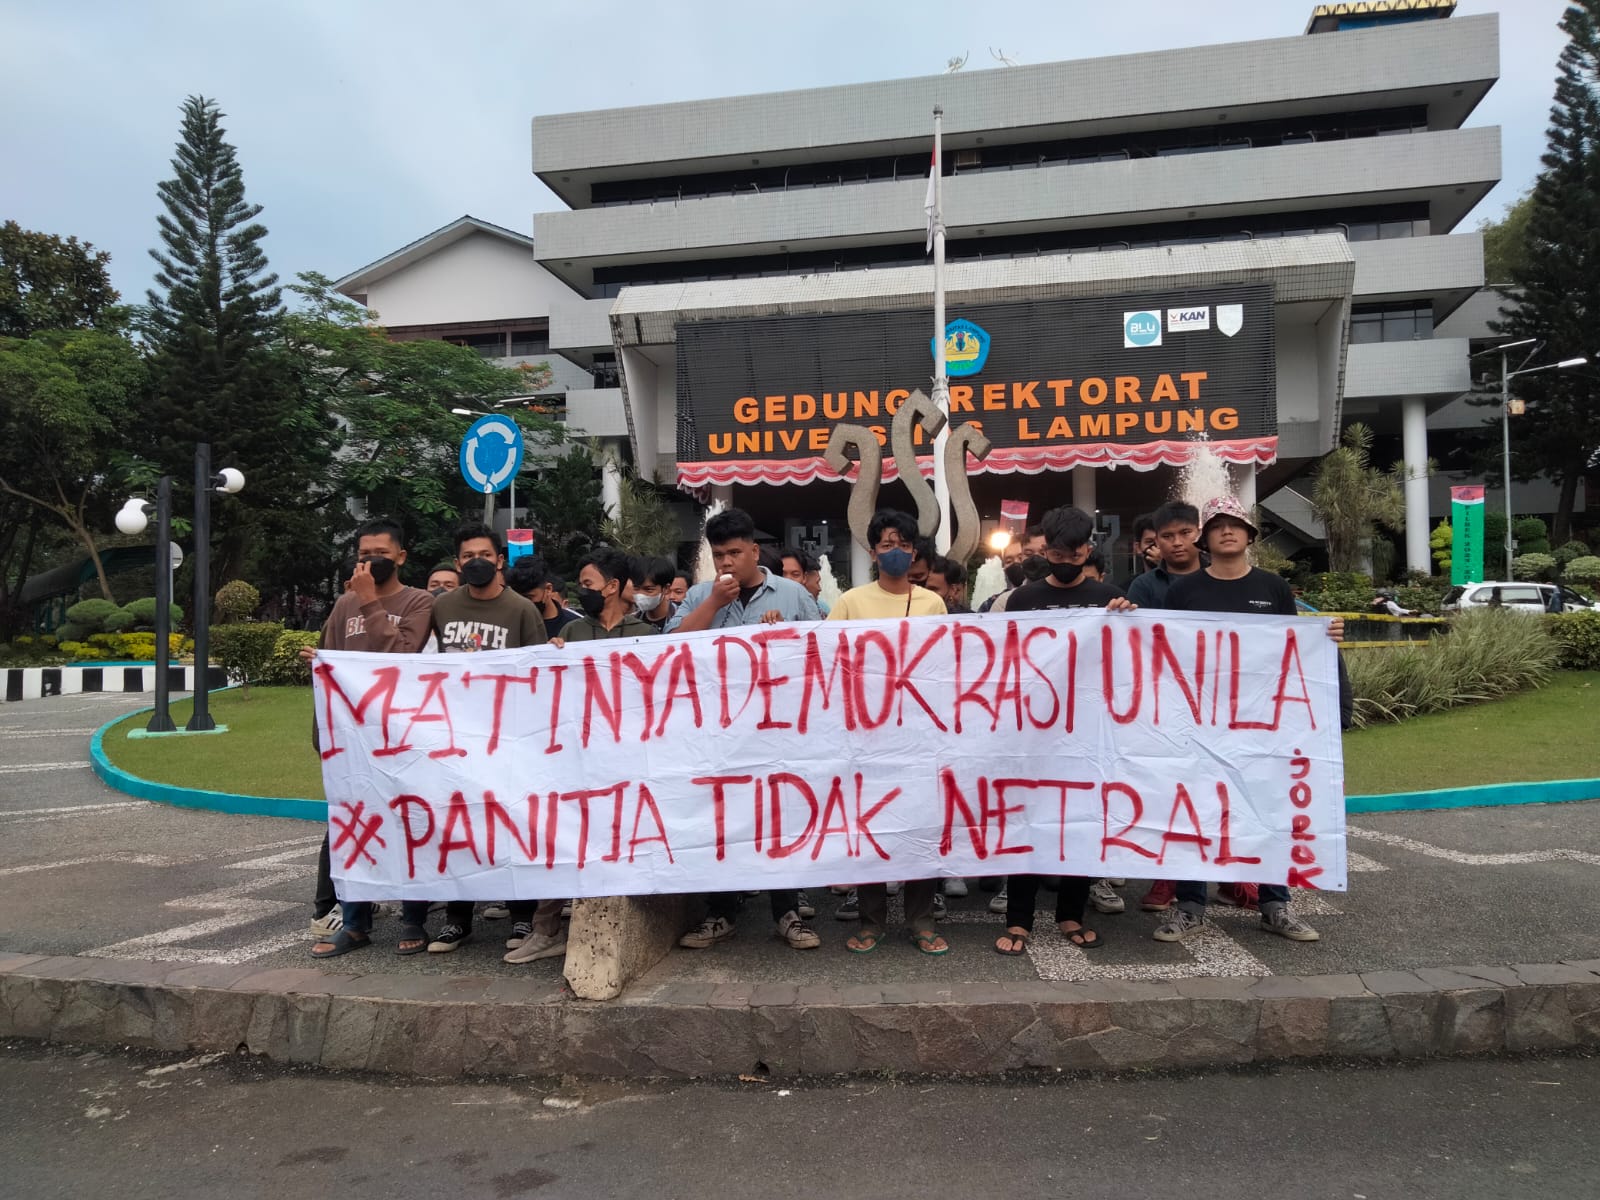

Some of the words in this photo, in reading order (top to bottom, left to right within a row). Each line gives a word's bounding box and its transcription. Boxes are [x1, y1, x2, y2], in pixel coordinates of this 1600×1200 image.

[1131, 322, 1156, 333] BLU
[1179, 311, 1206, 321] KAN
[733, 389, 911, 424] GEDUNG
[949, 372, 1207, 412] REKTORAT
[1014, 408, 1239, 440] LAMPUNG
[442, 621, 508, 649] SMITH
[1101, 624, 1317, 732] UNILA
[691, 772, 902, 862] TIDAK
[939, 767, 1262, 867] NETRAL
